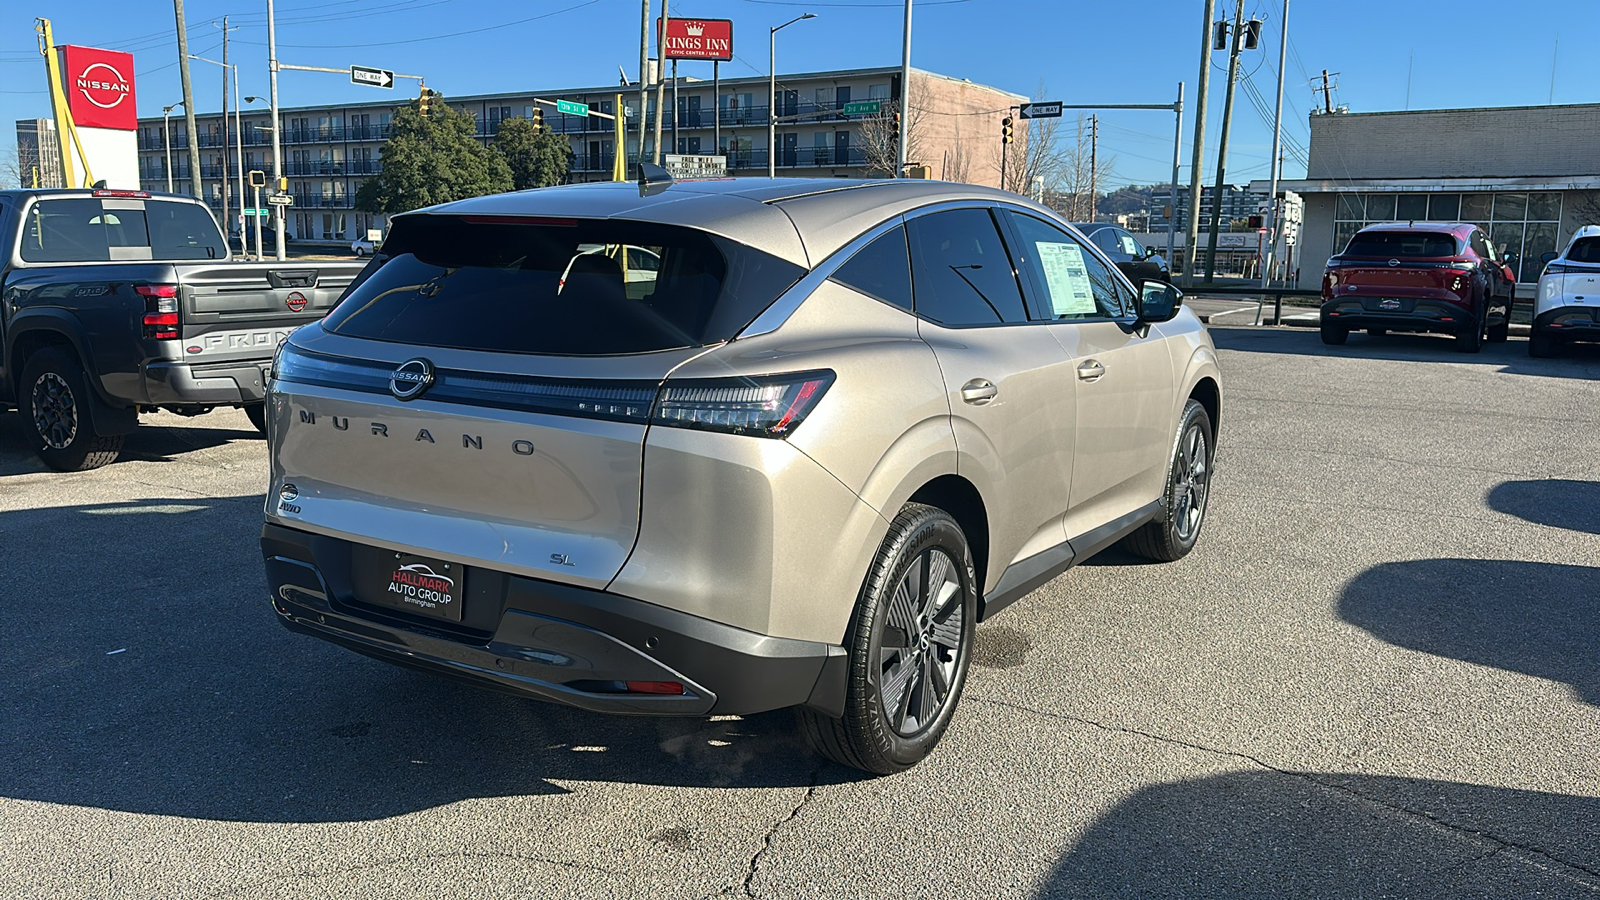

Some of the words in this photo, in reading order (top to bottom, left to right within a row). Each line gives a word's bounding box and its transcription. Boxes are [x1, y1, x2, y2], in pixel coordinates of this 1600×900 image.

[666, 37, 701, 49] KINGS
[706, 38, 729, 50] INN
[356, 71, 367, 79] ONE
[77, 79, 130, 92] NISSAN
[391, 372, 429, 383] NISSAN
[300, 410, 534, 455] MURANO
[279, 502, 301, 514] AWD
[549, 553, 576, 567] SL
[392, 571, 450, 593] HALLMARK
[388, 582, 416, 596] AUTO
[418, 589, 451, 604] GROUP
[404, 596, 436, 609] Birmingham
[868, 693, 890, 752] ALENZA
